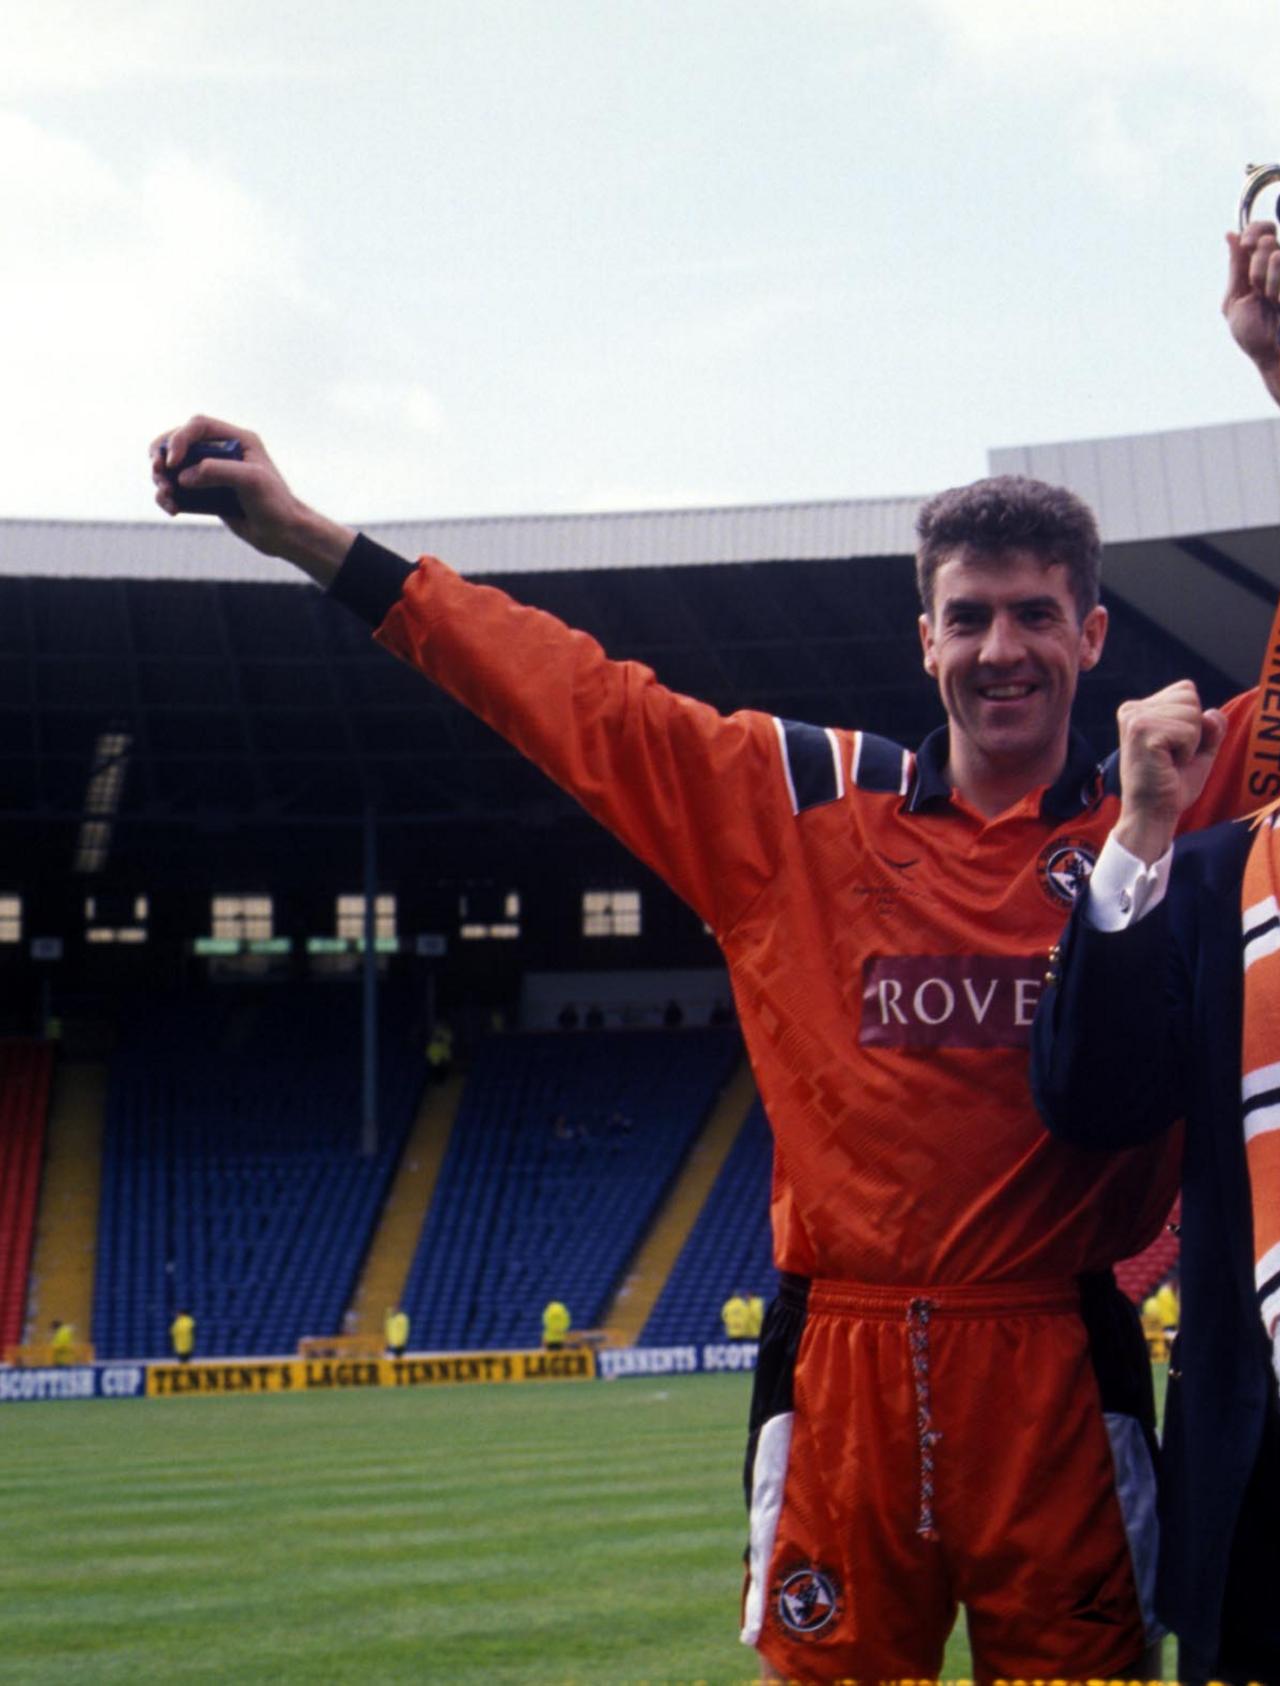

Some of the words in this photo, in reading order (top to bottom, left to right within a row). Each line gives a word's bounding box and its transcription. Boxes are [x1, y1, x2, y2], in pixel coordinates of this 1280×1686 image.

[878, 977, 1042, 1026] ROVE
[305, 1361, 381, 1387] LAGER
[523, 1353, 588, 1379] LAGER
[101, 1367, 141, 1396] CUP
